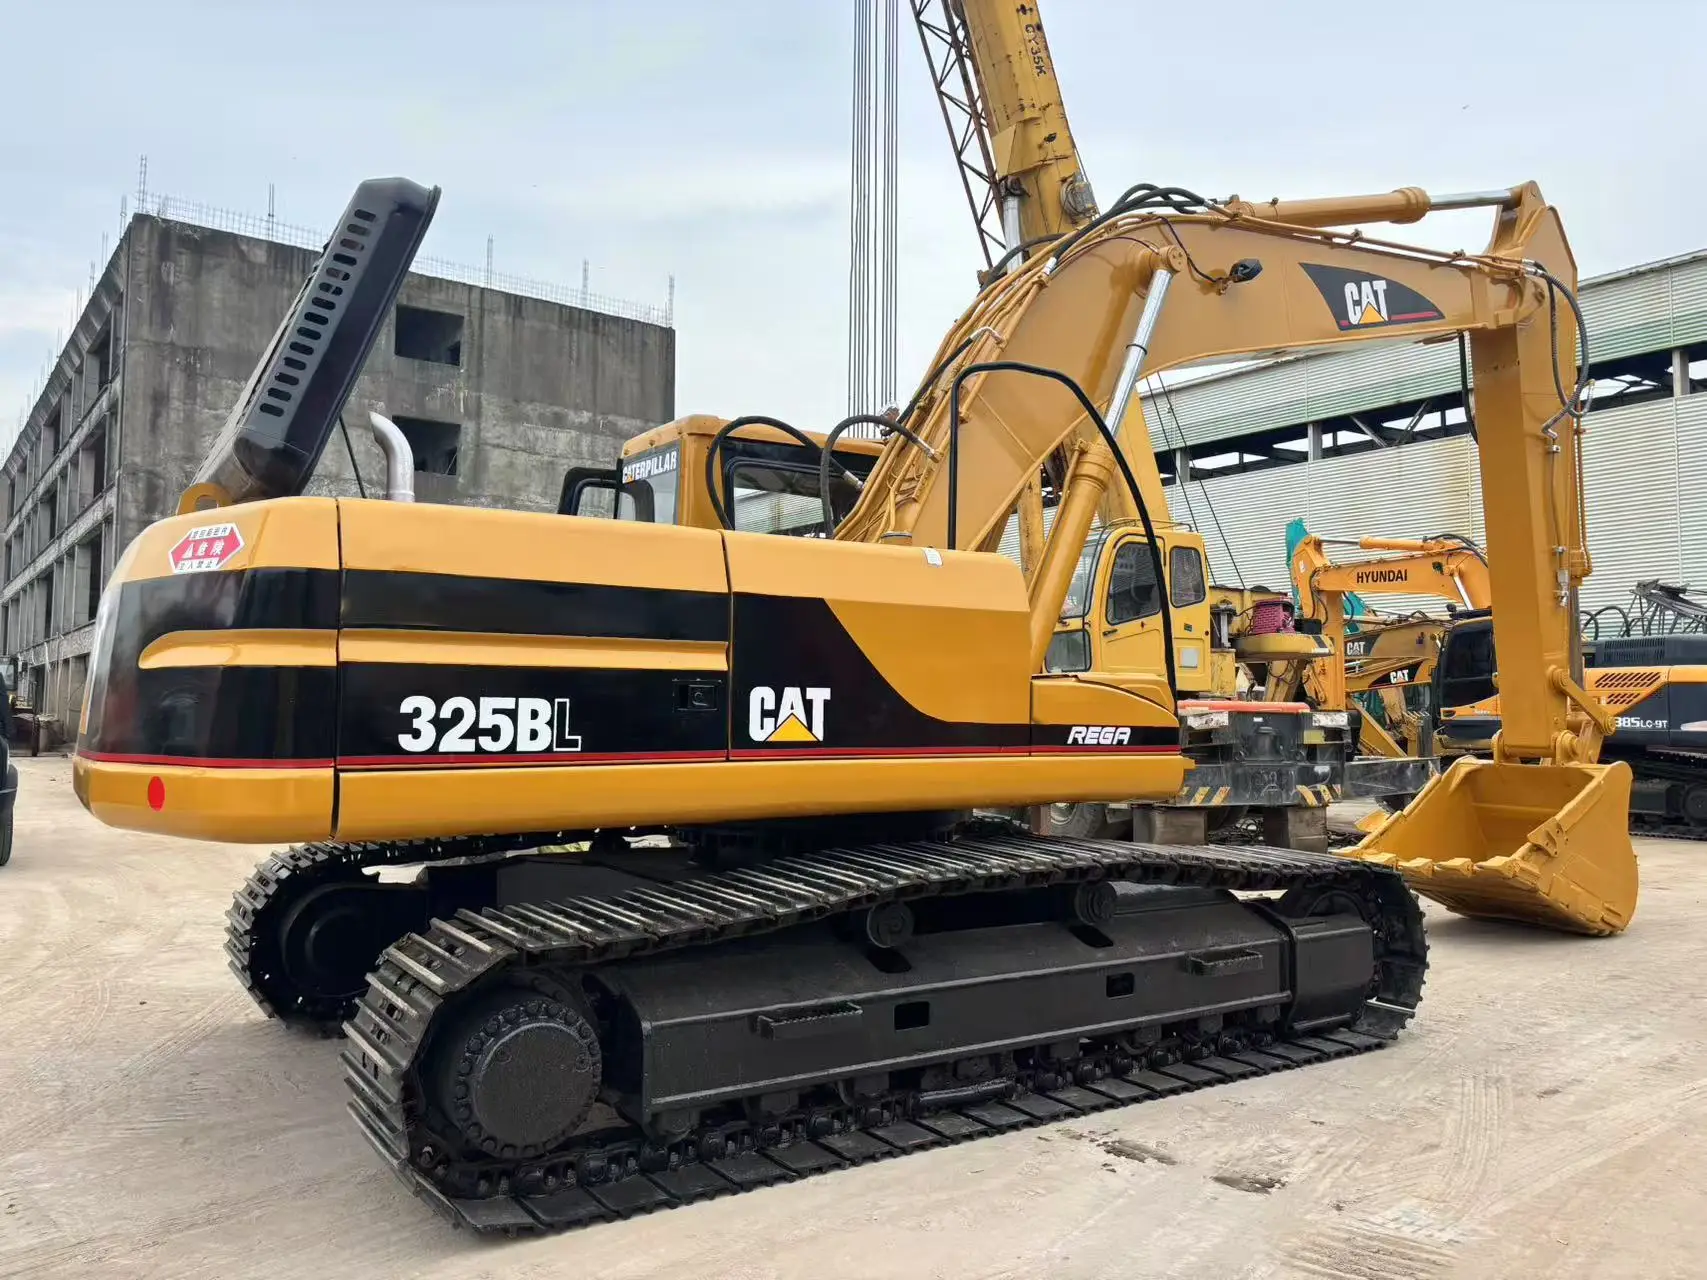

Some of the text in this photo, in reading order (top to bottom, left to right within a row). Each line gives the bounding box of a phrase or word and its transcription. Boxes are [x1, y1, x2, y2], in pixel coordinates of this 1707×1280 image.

[1344, 280, 1388, 325] CAT
[622, 450, 677, 484] CATERPILLAR
[1356, 569, 1408, 584] HYUNDAI
[1346, 641, 1365, 656] CAT
[1389, 669, 1409, 684] CAT
[749, 686, 831, 742] CAT
[1066, 726, 1132, 745] REGA
